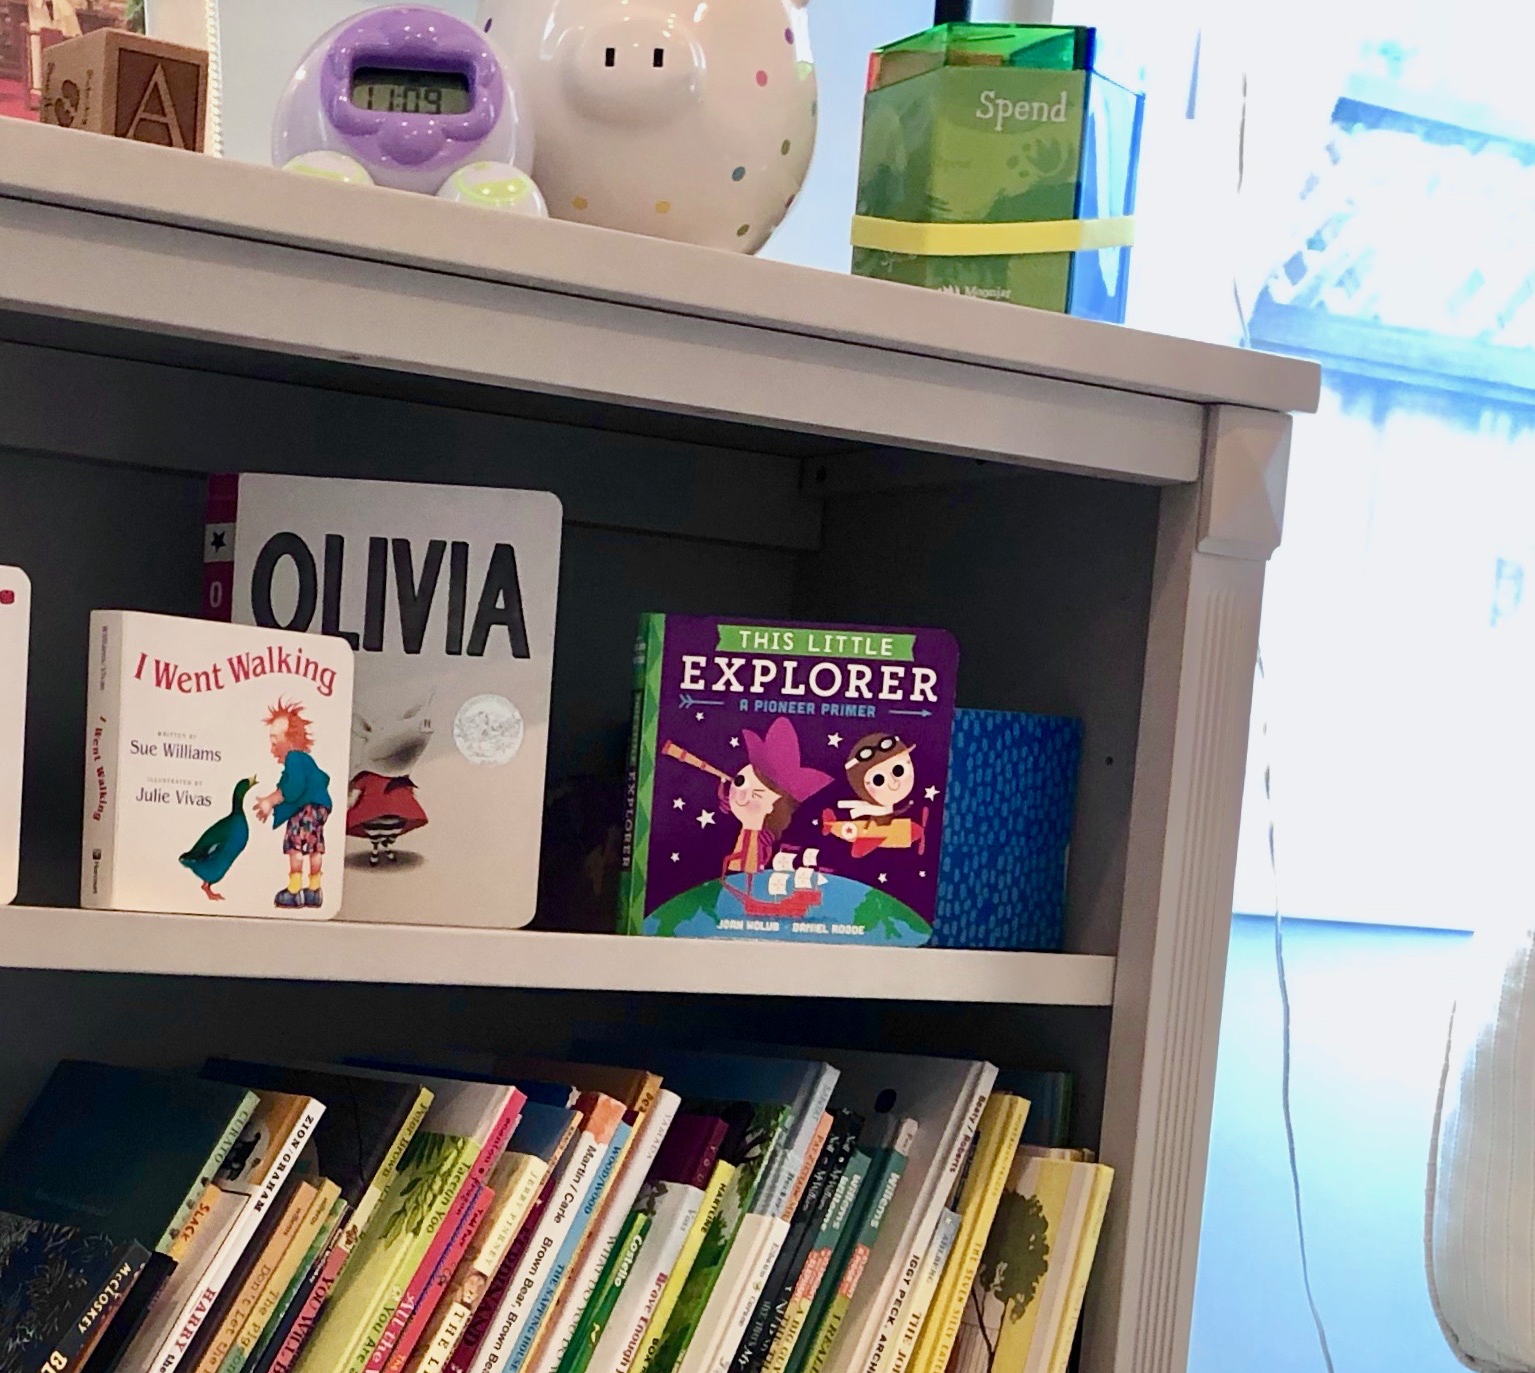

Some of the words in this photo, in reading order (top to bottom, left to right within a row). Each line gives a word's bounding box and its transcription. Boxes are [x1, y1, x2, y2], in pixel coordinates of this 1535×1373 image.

[125, 63, 184, 149] A
[367, 86, 442, 114] 11:09
[976, 90, 1066, 131] Spend
[251, 531, 531, 659] OLIVIA
[739, 630, 797, 651] THIS
[808, 634, 894, 656] LITTLE
[134, 652, 148, 680] I
[153, 659, 225, 694] Went
[227, 646, 337, 697] Walking
[680, 655, 938, 703] EXPLORER
[739, 699, 750, 712] A
[754, 699, 816, 717] PIONEER
[821, 702, 876, 718] PRIMER
[130, 740, 157, 756] Sue
[163, 743, 222, 762] Williams
[136, 787, 170, 803] Julie
[176, 790, 212, 807] Vivas
[621, 770, 636, 868] EXPLORER
[212, 1109, 250, 1164] CURATO
[569, 1144, 598, 1185] Martin
[423, 1205, 446, 1236] Yoo
[552, 1190, 575, 1226] Carle
[868, 1171, 899, 1229] Willems
[179, 1202, 210, 1243] SLACK
[526, 1235, 554, 1277] Brown
[609, 1232, 644, 1289] Costello
[901, 1254, 920, 1285] IGGY
[74, 1261, 133, 1334] McCLOSKEY
[241, 1263, 272, 1308] Don't
[306, 1273, 334, 1312] YOU
[508, 1276, 534, 1311] Bear,
[642, 1270, 669, 1315] Brave
[172, 1286, 216, 1352] HARRY
[223, 1308, 246, 1336] Let
[370, 1303, 394, 1333] You
[390, 1290, 420, 1330] All
[436, 1308, 465, 1349] THE
[900, 1311, 921, 1346] THE
[279, 1311, 314, 1361] WILL
[354, 1335, 378, 1365] Are
[370, 1328, 400, 1366] the
[490, 1310, 518, 1352] Brown
[616, 1315, 650, 1369] Enough
[207, 1339, 229, 1367] the
